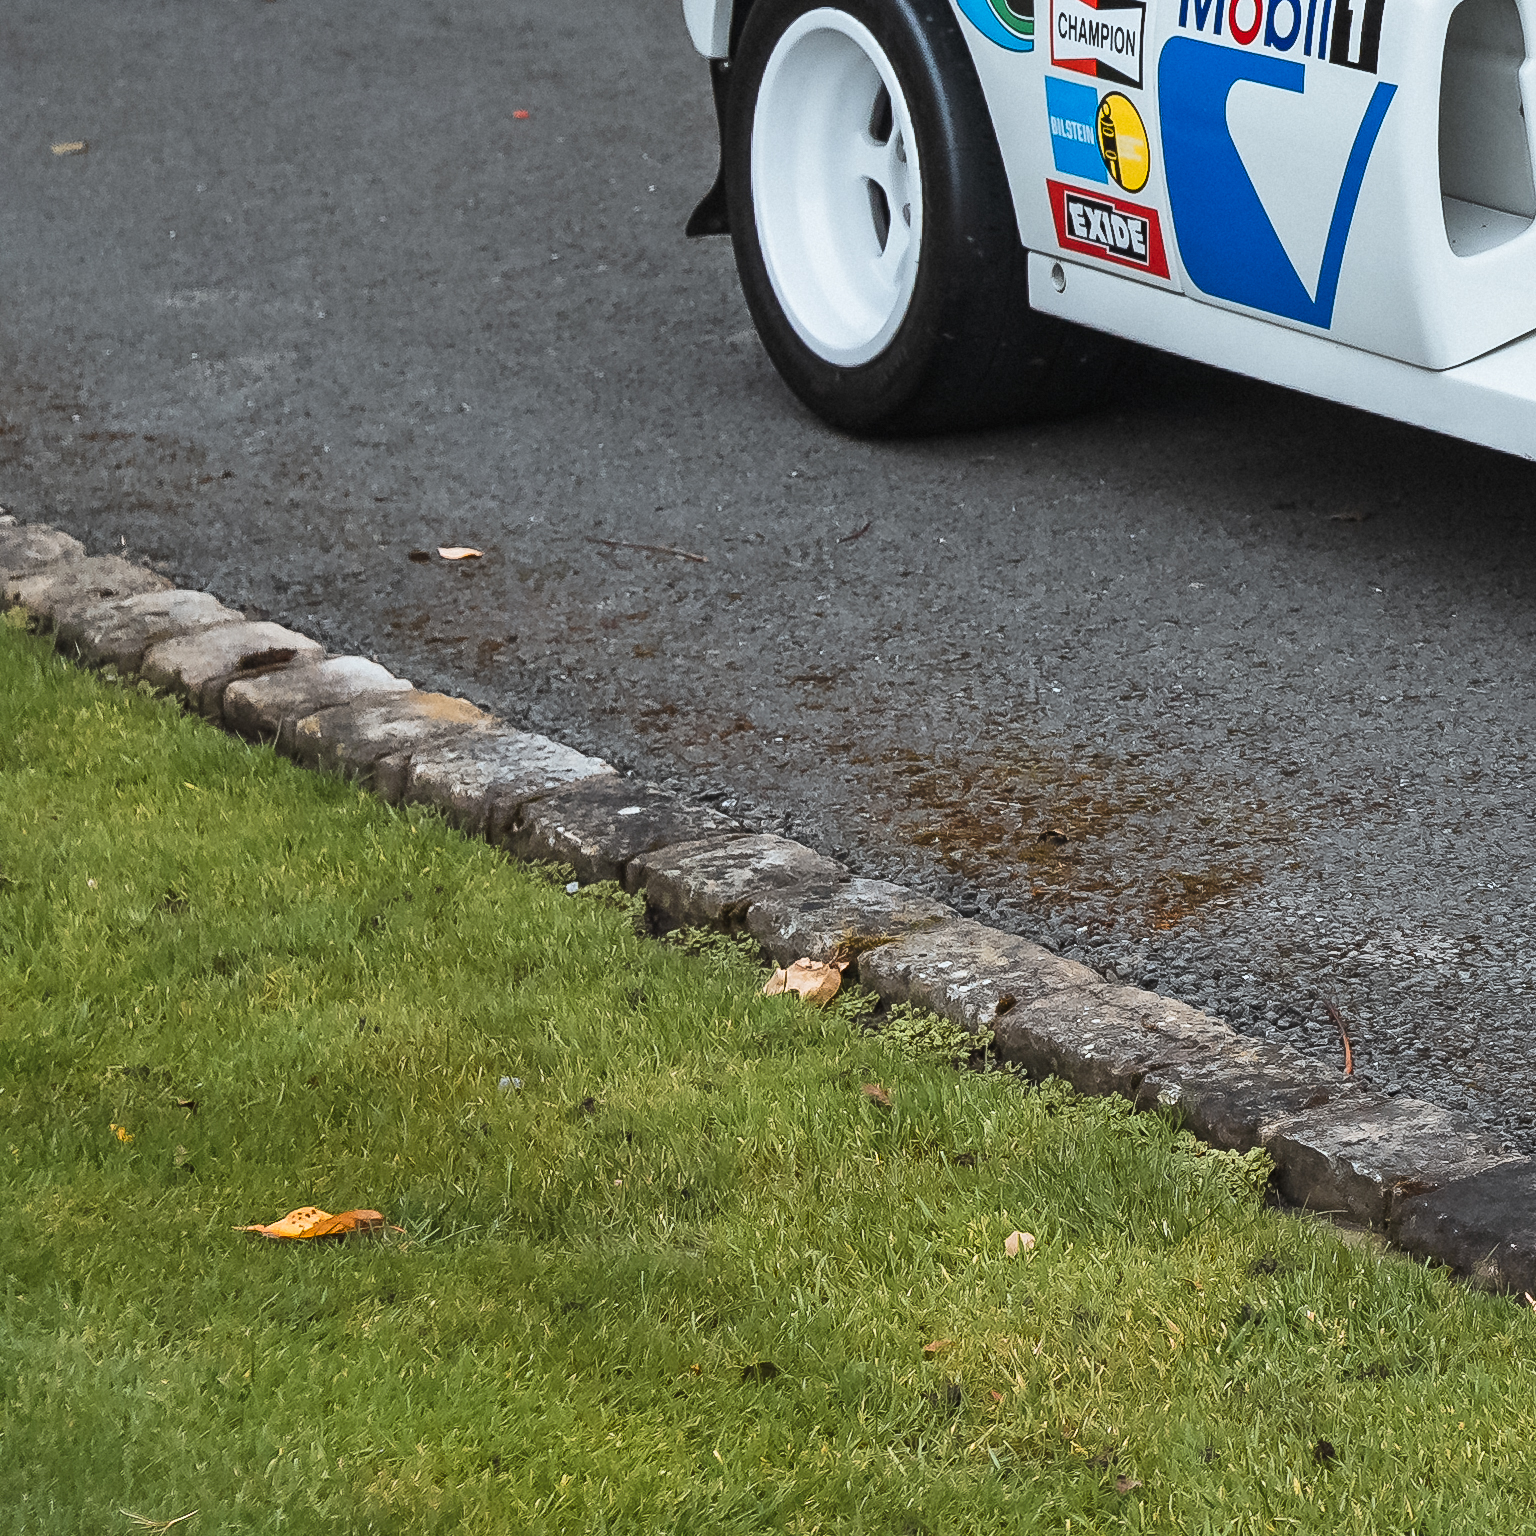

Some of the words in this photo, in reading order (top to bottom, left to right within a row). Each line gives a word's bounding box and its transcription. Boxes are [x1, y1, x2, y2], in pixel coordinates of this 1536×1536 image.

[1058, 12, 1136, 57] CHAMPION
[1050, 115, 1095, 146] BILSTEIN
[1068, 201, 1146, 255] EXIDE
